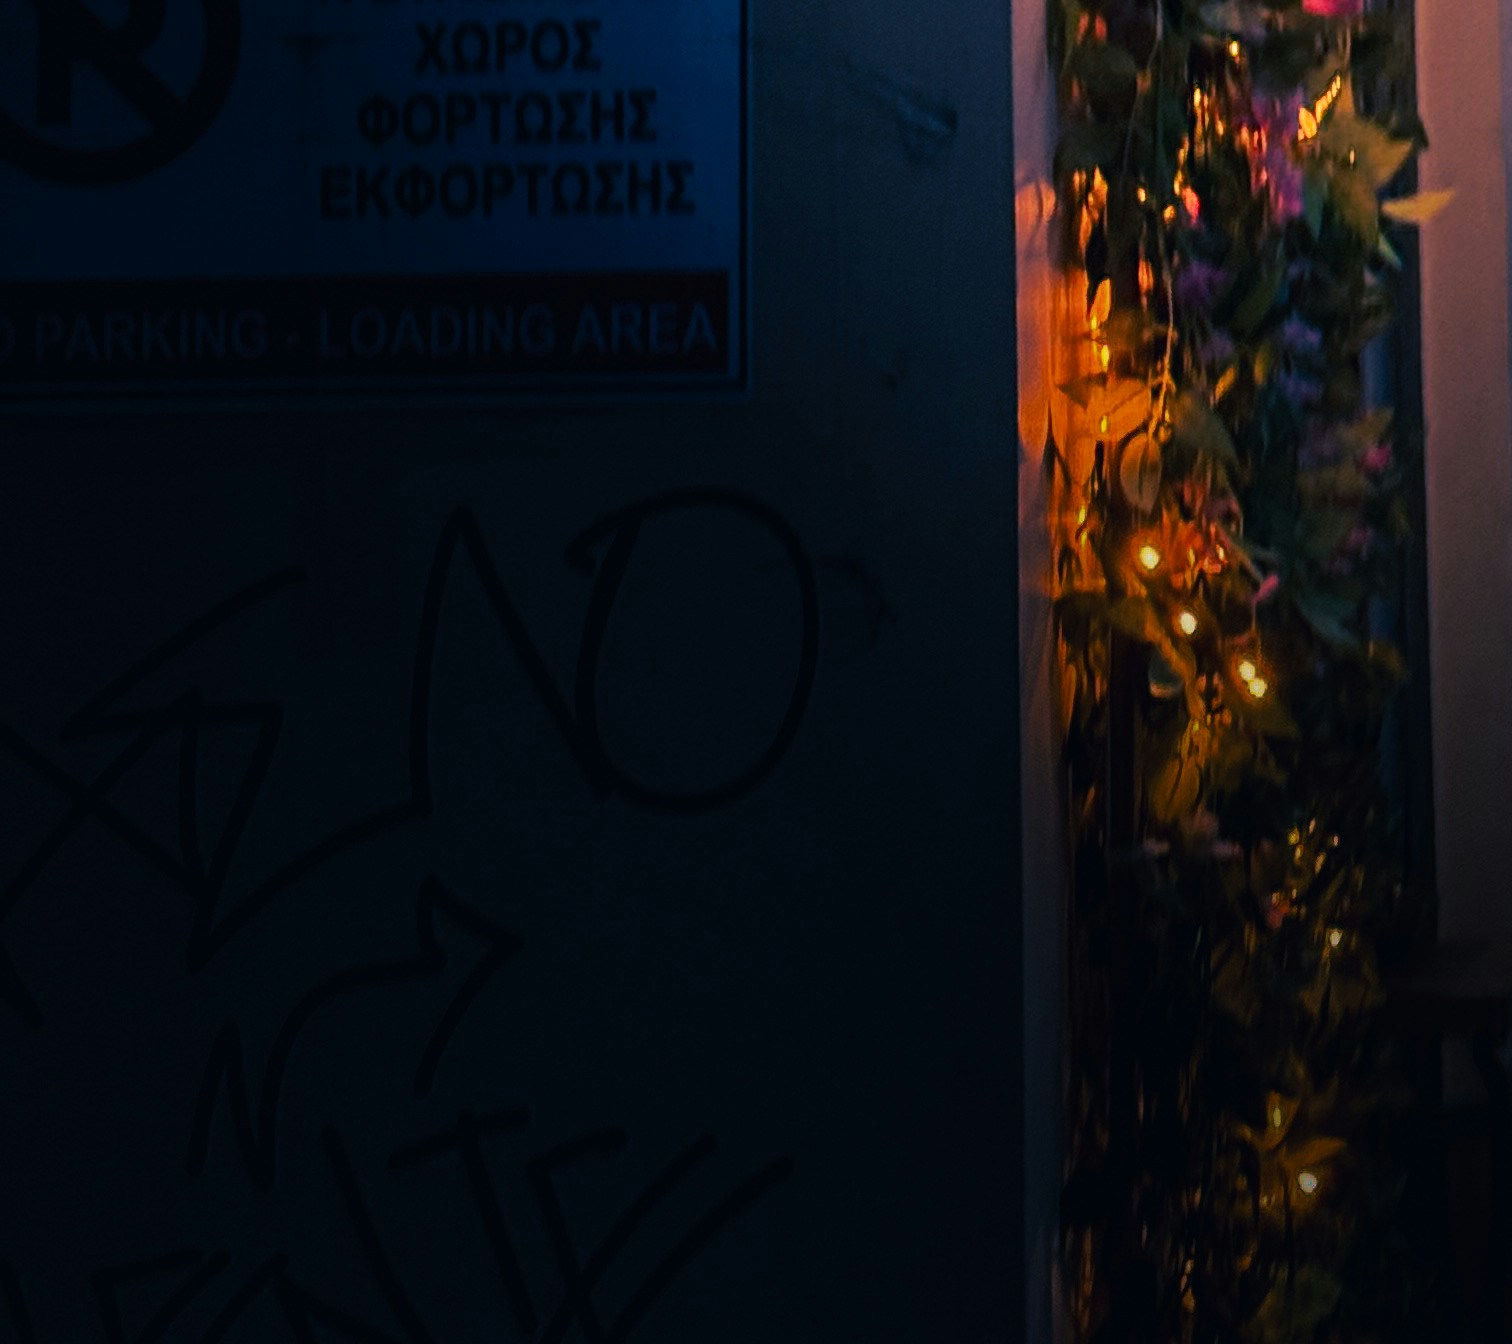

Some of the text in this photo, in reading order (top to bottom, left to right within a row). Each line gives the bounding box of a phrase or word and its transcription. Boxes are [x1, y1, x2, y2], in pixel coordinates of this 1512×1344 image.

[415, 18, 602, 74] ΧΩΡΟΣ
[357, 88, 657, 146] ΦΟΡΤΩΣΗΣ
[319, 159, 696, 220] ΕΚΦΟΡΤΩΣΗΣ
[35, 308, 267, 361] PARKING
[319, 303, 558, 359] LOADING
[573, 299, 719, 355] AREA
